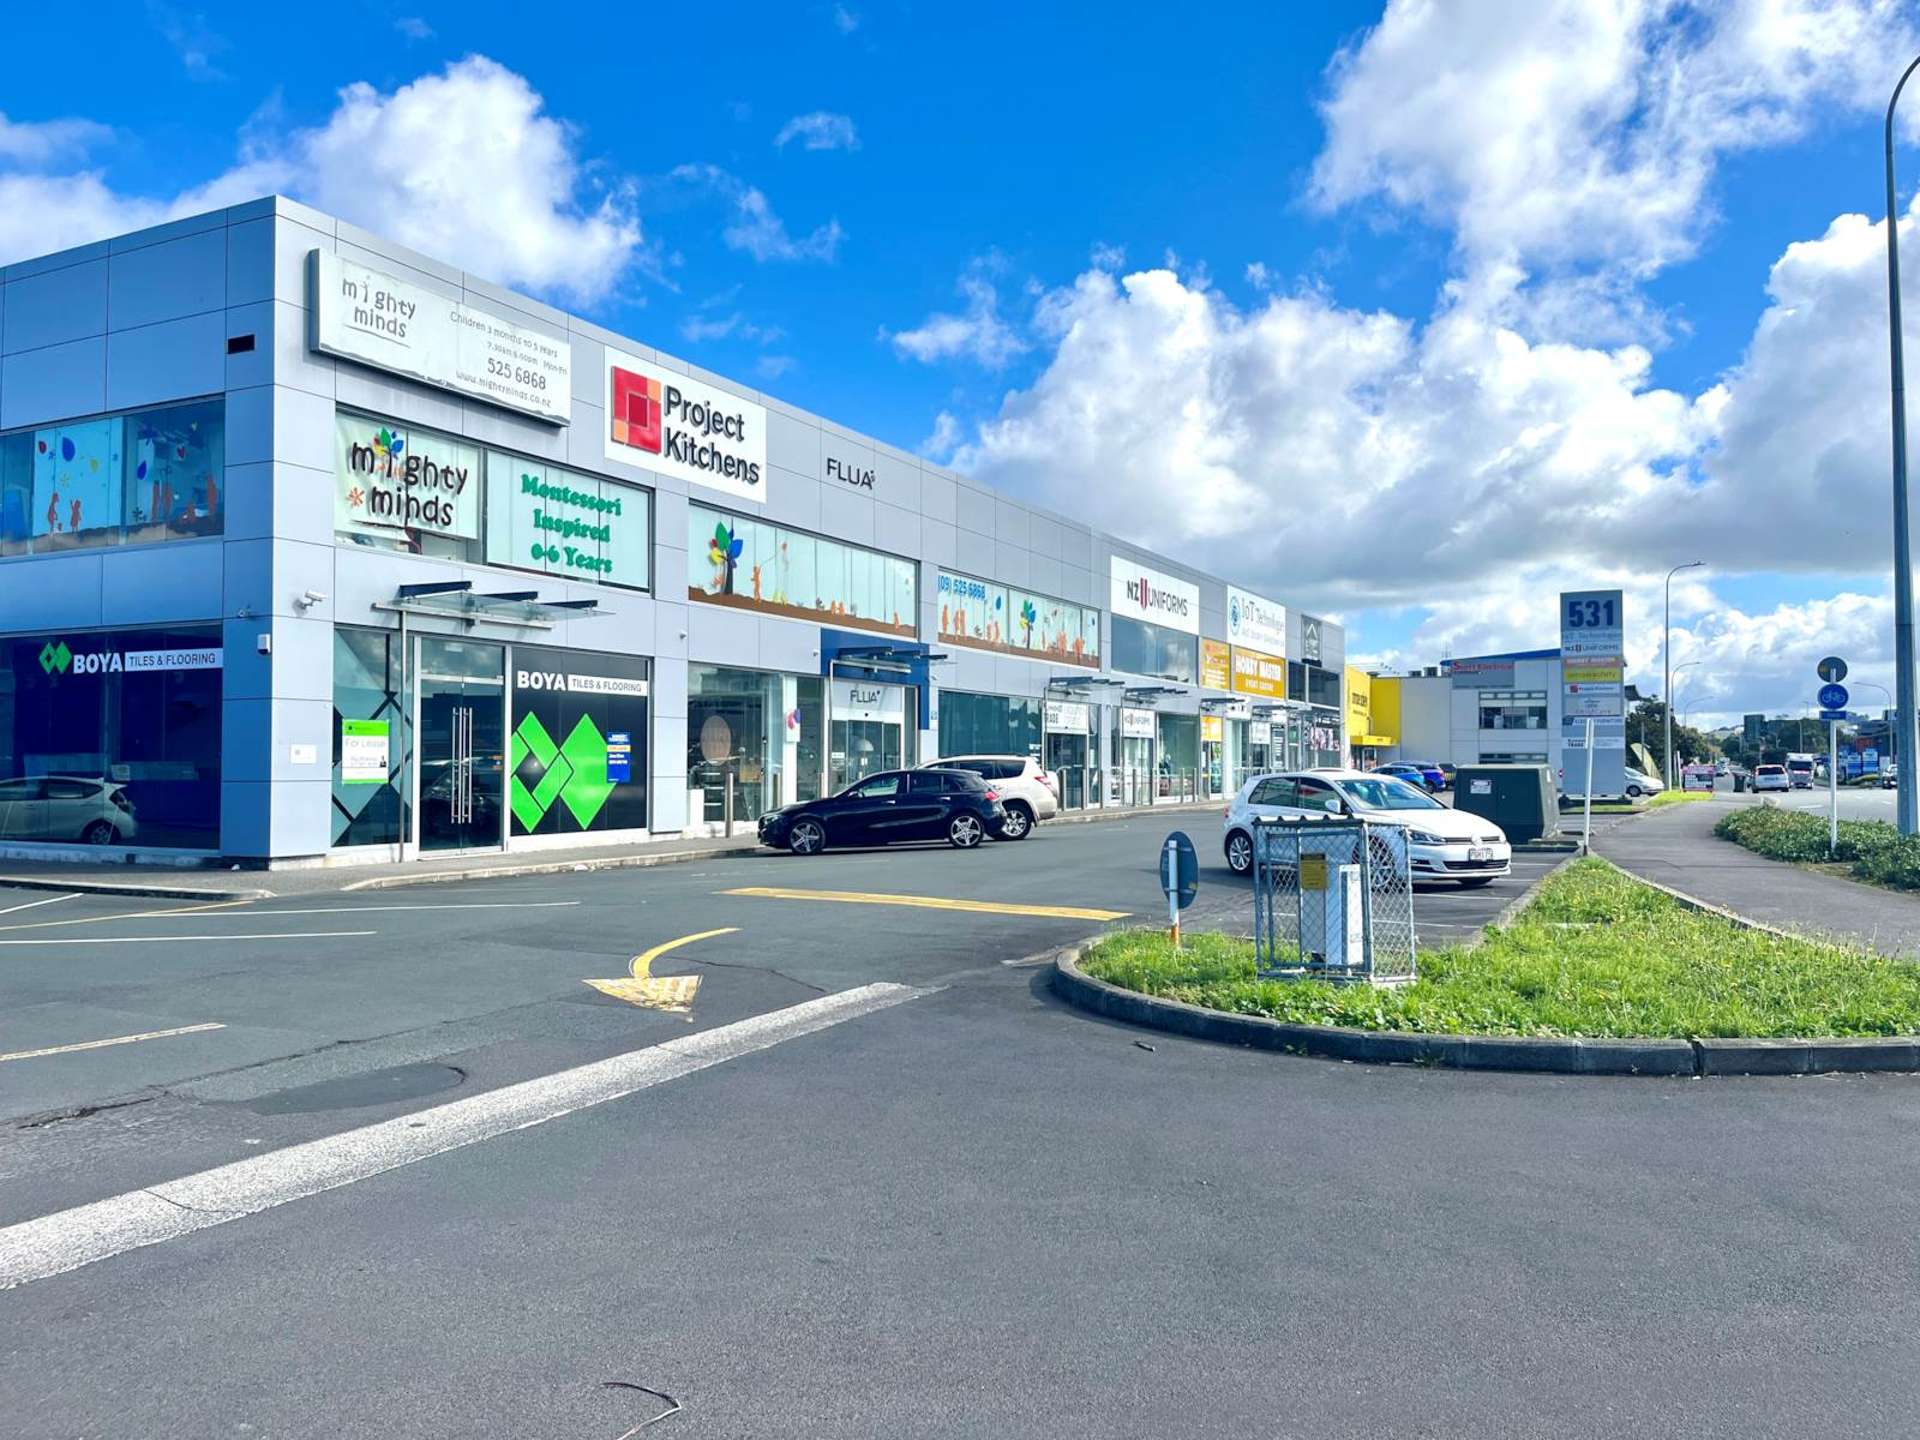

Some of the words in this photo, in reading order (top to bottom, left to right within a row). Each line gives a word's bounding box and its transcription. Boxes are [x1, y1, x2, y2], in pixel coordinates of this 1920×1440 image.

[342, 276, 416, 319] mighty
[354, 306, 407, 338] minds
[450, 311, 486, 331] Children
[487, 357, 512, 379] 525
[515, 366, 546, 390] 6868
[664, 385, 745, 442] Project
[351, 441, 468, 495] mighty
[664, 427, 760, 485] Kitchens
[371, 486, 454, 527] minds
[521, 474, 622, 516] Montessori
[533, 508, 611, 543] Inspired
[531, 543, 560, 563] 0-6
[564, 546, 613, 573] Years
[938, 575, 950, 591] (09)
[953, 579, 967, 594] 525
[968, 582, 986, 599] 6868
[1127, 580, 1140, 602] NZ
[1148, 588, 1188, 616] UNIFORMS
[1568, 600, 1614, 628] 531
[73, 653, 123, 674] BOYA
[129, 655, 154, 666] TILES
[157, 654, 163, 665] &
[166, 652, 216, 666] FLOORING
[517, 670, 566, 691] BOYA
[572, 678, 594, 689] TILES
[596, 680, 601, 689] &
[603, 680, 642, 693] FLOORING
